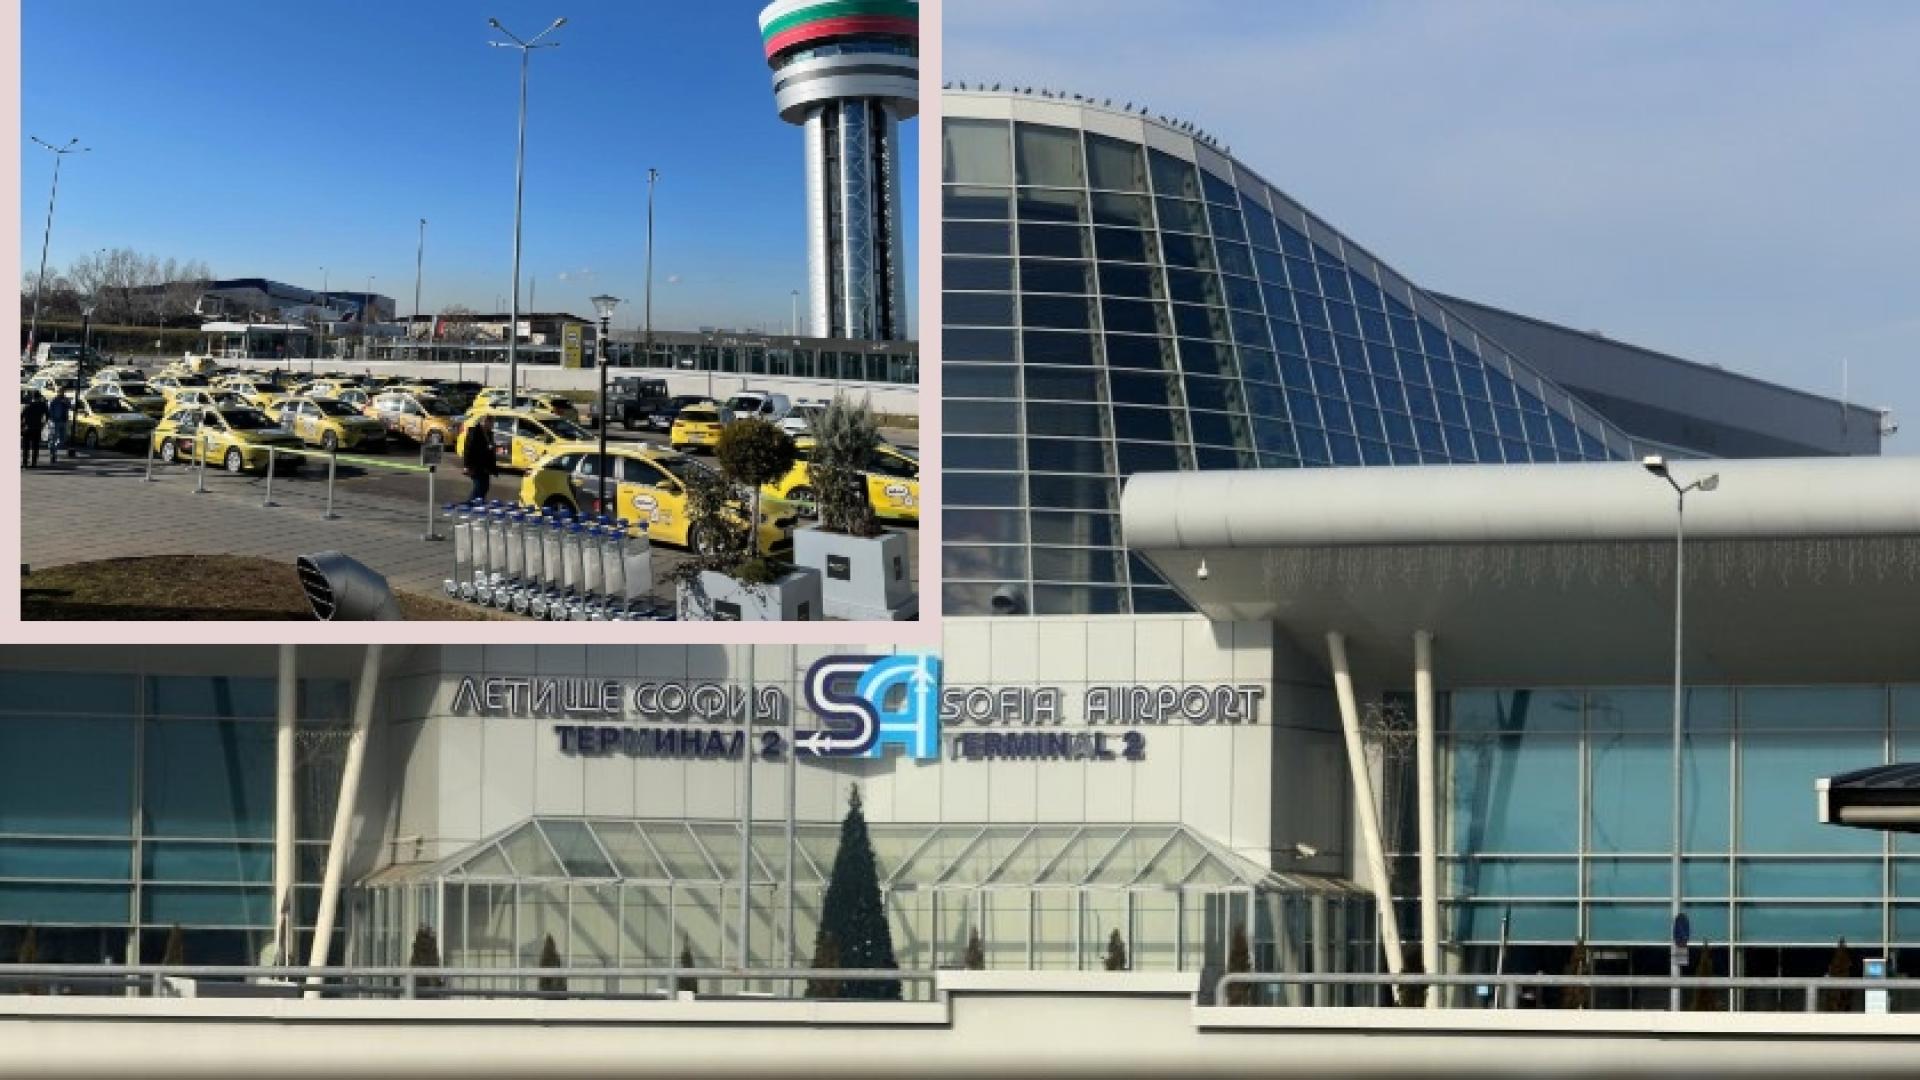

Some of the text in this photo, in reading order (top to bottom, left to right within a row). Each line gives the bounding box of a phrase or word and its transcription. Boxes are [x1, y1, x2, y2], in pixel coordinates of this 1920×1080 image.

[634, 682, 783, 720] СОФИЯ
[939, 685, 1262, 724] SOFIA AIRPORT
[761, 729, 781, 755] 2
[945, 730, 1145, 760] TERMINAL 2
